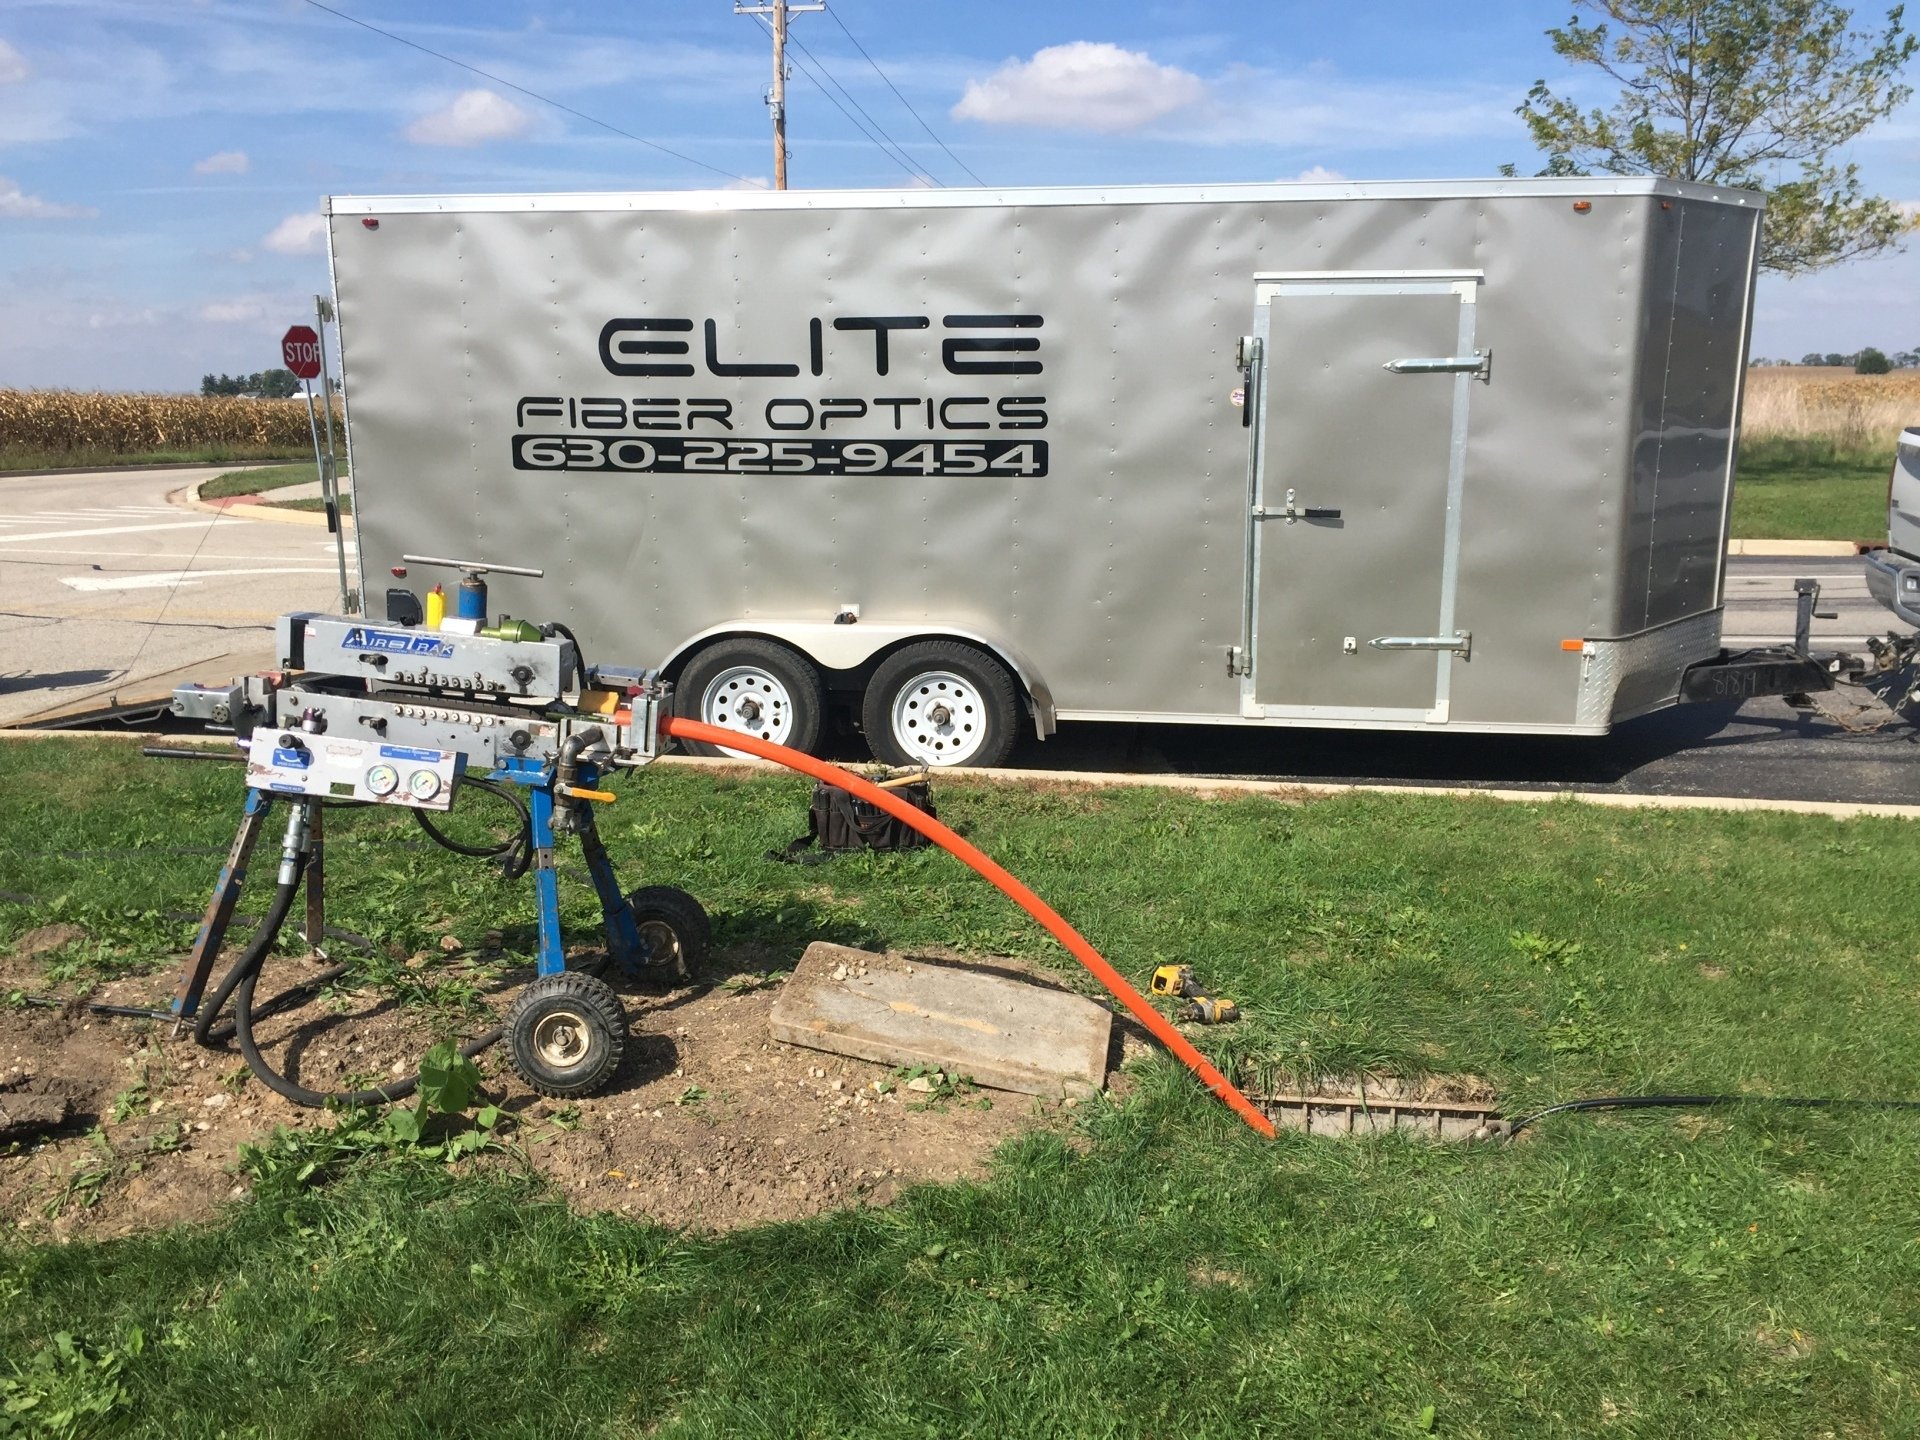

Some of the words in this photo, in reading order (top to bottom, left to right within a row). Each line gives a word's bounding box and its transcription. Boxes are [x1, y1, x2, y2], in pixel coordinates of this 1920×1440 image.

[285, 342, 320, 363] STOP
[598, 314, 1044, 378] ELITE
[516, 396, 734, 430] FIBER
[765, 396, 1049, 431] OPTICS
[520, 437, 1041, 475] 630-225-9454
